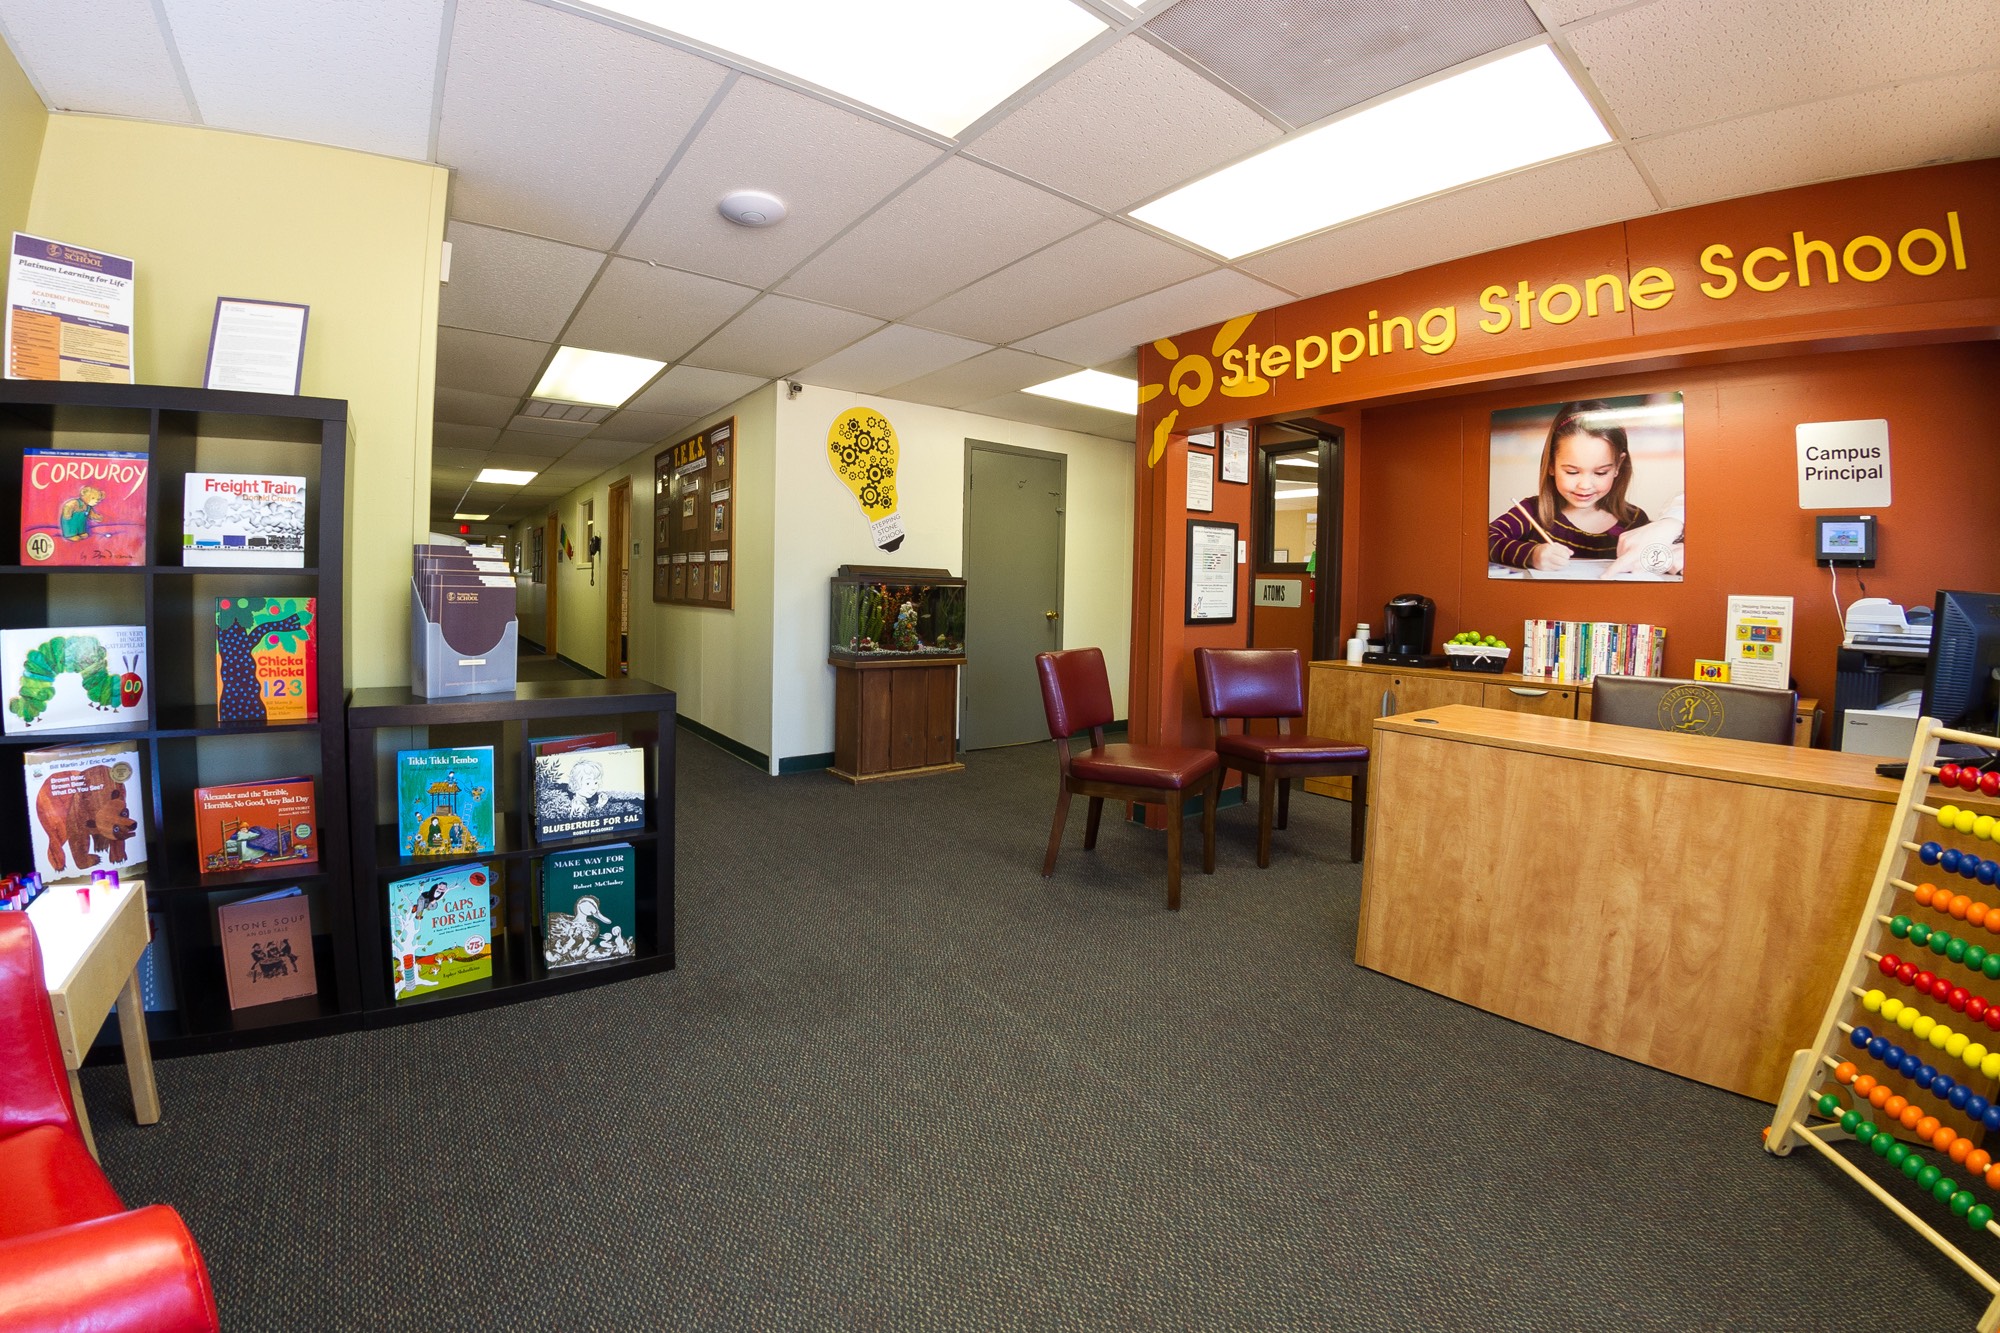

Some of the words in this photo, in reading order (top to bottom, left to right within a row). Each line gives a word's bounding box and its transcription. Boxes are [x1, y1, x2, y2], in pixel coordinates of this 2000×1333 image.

[64, 252, 102, 267] SCHOOL
[19, 259, 57, 272] Platinum
[58, 268, 94, 282] Learning
[32, 290, 66, 301] ACADEMIC
[68, 297, 110, 310] FOUNDATION
[1221, 306, 1457, 388] Stepping
[1478, 266, 1676, 335] Stone
[1700, 210, 1967, 300] School
[1806, 446, 1881, 462] Campus
[32, 462, 147, 500] CORDUROY
[1805, 464, 1883, 482] Principal
[205, 479, 258, 496] Freight
[261, 480, 296, 494] Train
[871, 514, 901, 530] STEPPING
[877, 522, 898, 536] STONE
[877, 529, 903, 544] SCHOOL
[32, 538, 48, 554] 40
[1263, 584, 1285, 602] ATOMS
[258, 656, 303, 666] Chicka
[258, 668, 304, 678] Chicka
[1662, 688, 1698, 711] STEPPING
[407, 756, 427, 765] Tikki
[429, 756, 449, 764] Tikki
[450, 755, 478, 764] Tembo
[204, 792, 237, 801] Alexander
[262, 789, 288, 797] Terrible,
[542, 820, 600, 834] BLUEBERRIES
[603, 816, 620, 826] FOR
[624, 814, 639, 823] SAL
[554, 860, 581, 868] MAKE
[606, 855, 624, 863] FOR
[573, 866, 624, 878] DUCKLINGS
[444, 898, 473, 913] CAPS
[228, 920, 267, 933] STONE
[274, 915, 305, 926] SOUP
[432, 914, 456, 928] FOR
[458, 906, 486, 923] SALE
[470, 941, 480, 950] 75
